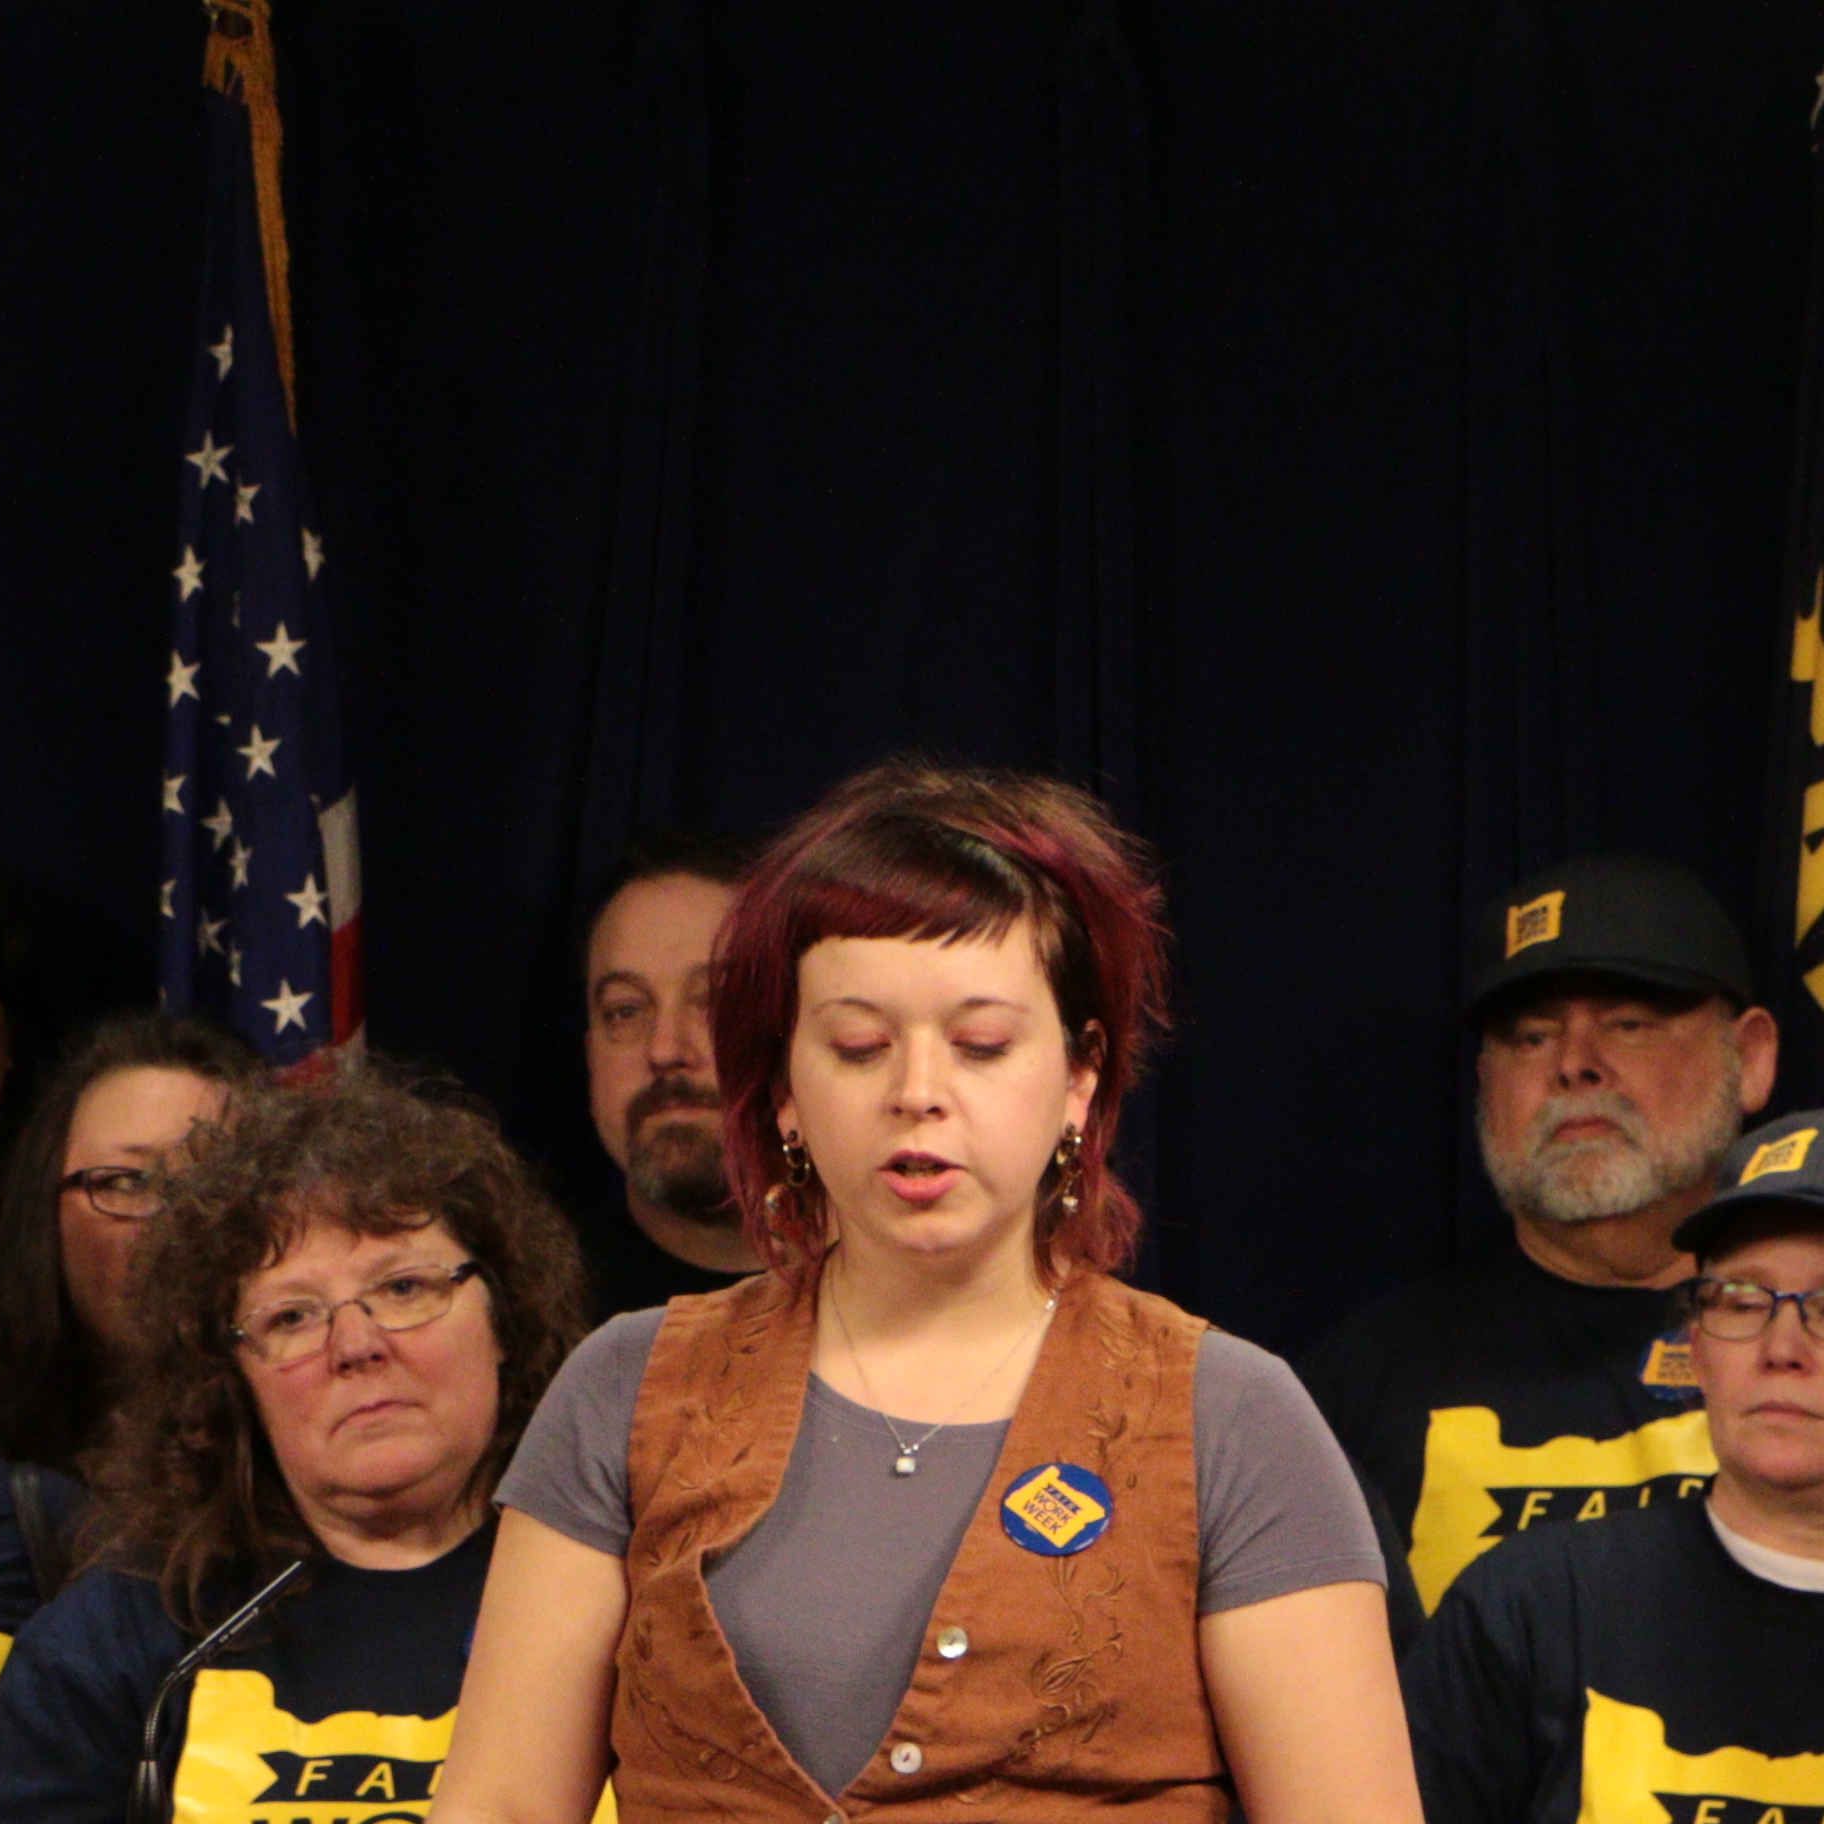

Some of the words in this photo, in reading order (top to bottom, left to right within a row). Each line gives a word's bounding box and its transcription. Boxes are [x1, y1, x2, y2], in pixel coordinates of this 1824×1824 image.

[1023, 1500, 1063, 1535] WEEK
[1033, 1491, 1072, 1525] WORK
[295, 1759, 444, 1800] FAI
